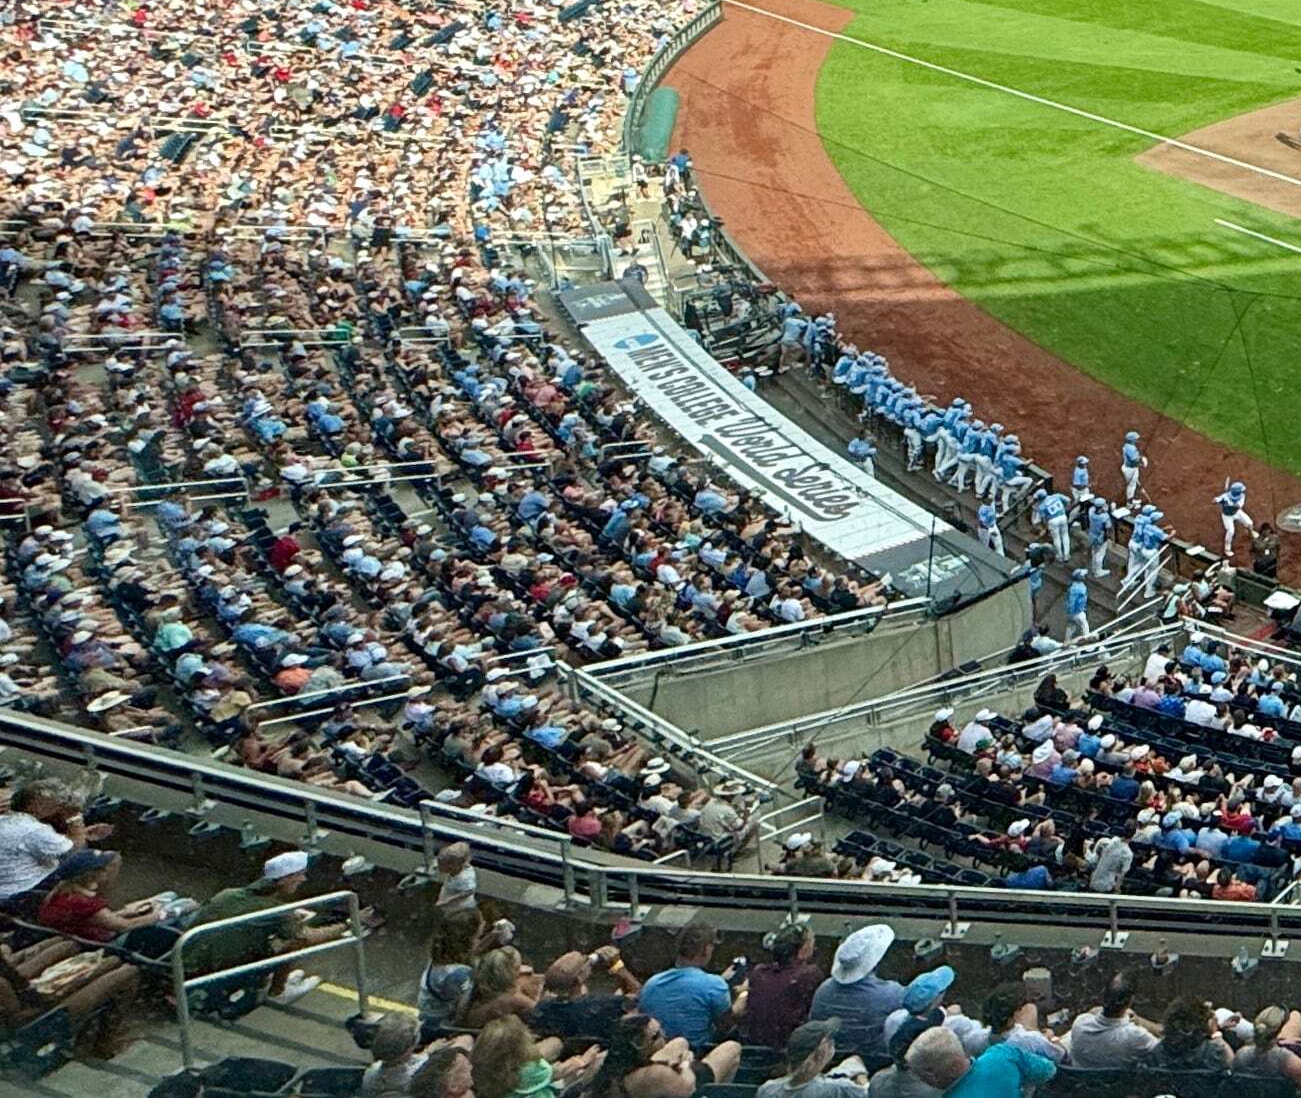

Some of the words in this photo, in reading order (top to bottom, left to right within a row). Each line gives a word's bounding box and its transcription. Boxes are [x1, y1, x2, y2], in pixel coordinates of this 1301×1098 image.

[625, 342, 683, 381] MEN'S
[656, 374, 741, 429] COLLEGE
[714, 415, 795, 468] World
[772, 462, 860, 518] Series
